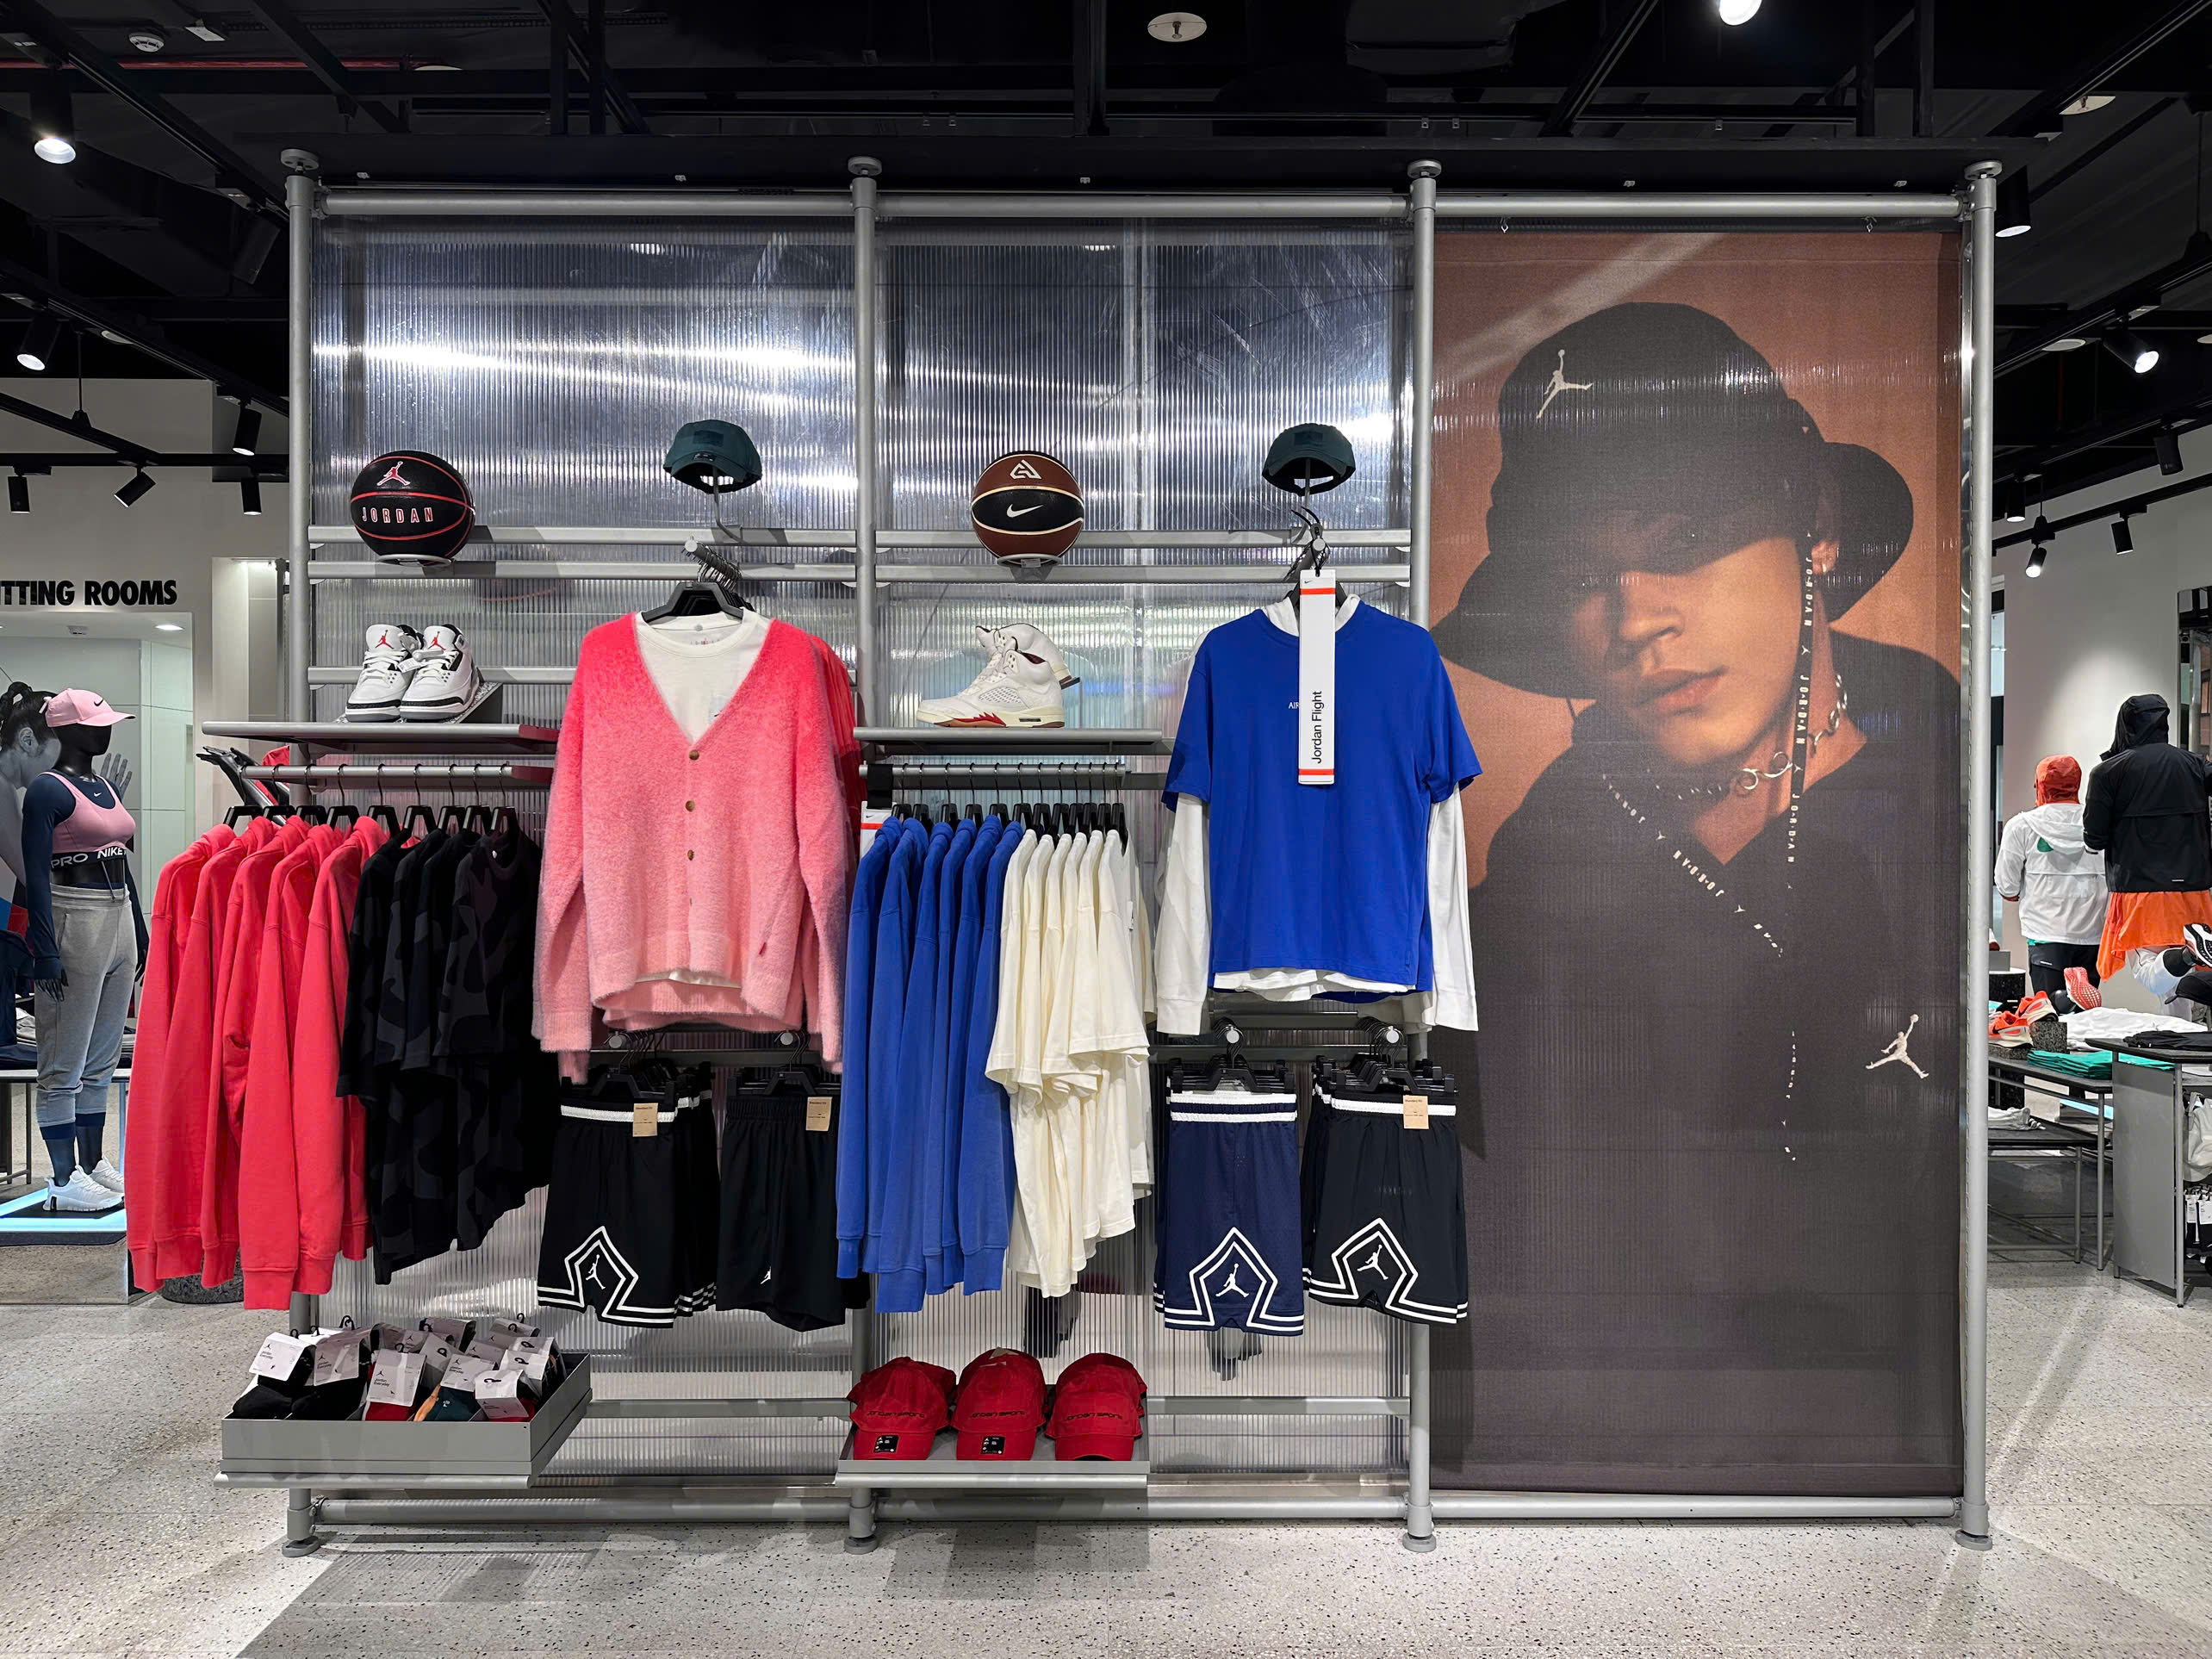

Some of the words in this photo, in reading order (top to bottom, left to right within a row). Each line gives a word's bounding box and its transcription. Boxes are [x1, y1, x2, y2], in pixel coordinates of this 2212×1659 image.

[362, 506, 433, 524] JORDAN
[0, 580, 75, 606] TTING
[84, 580, 177, 606] ROOMS
[1312, 691, 1324, 722] Flight
[1796, 674, 1809, 744] JORDAN
[1312, 724, 1322, 764] Jordan
[1787, 793, 1800, 863] JORDAN
[51, 853, 89, 869] PRO
[97, 847, 122, 859] NIKE
